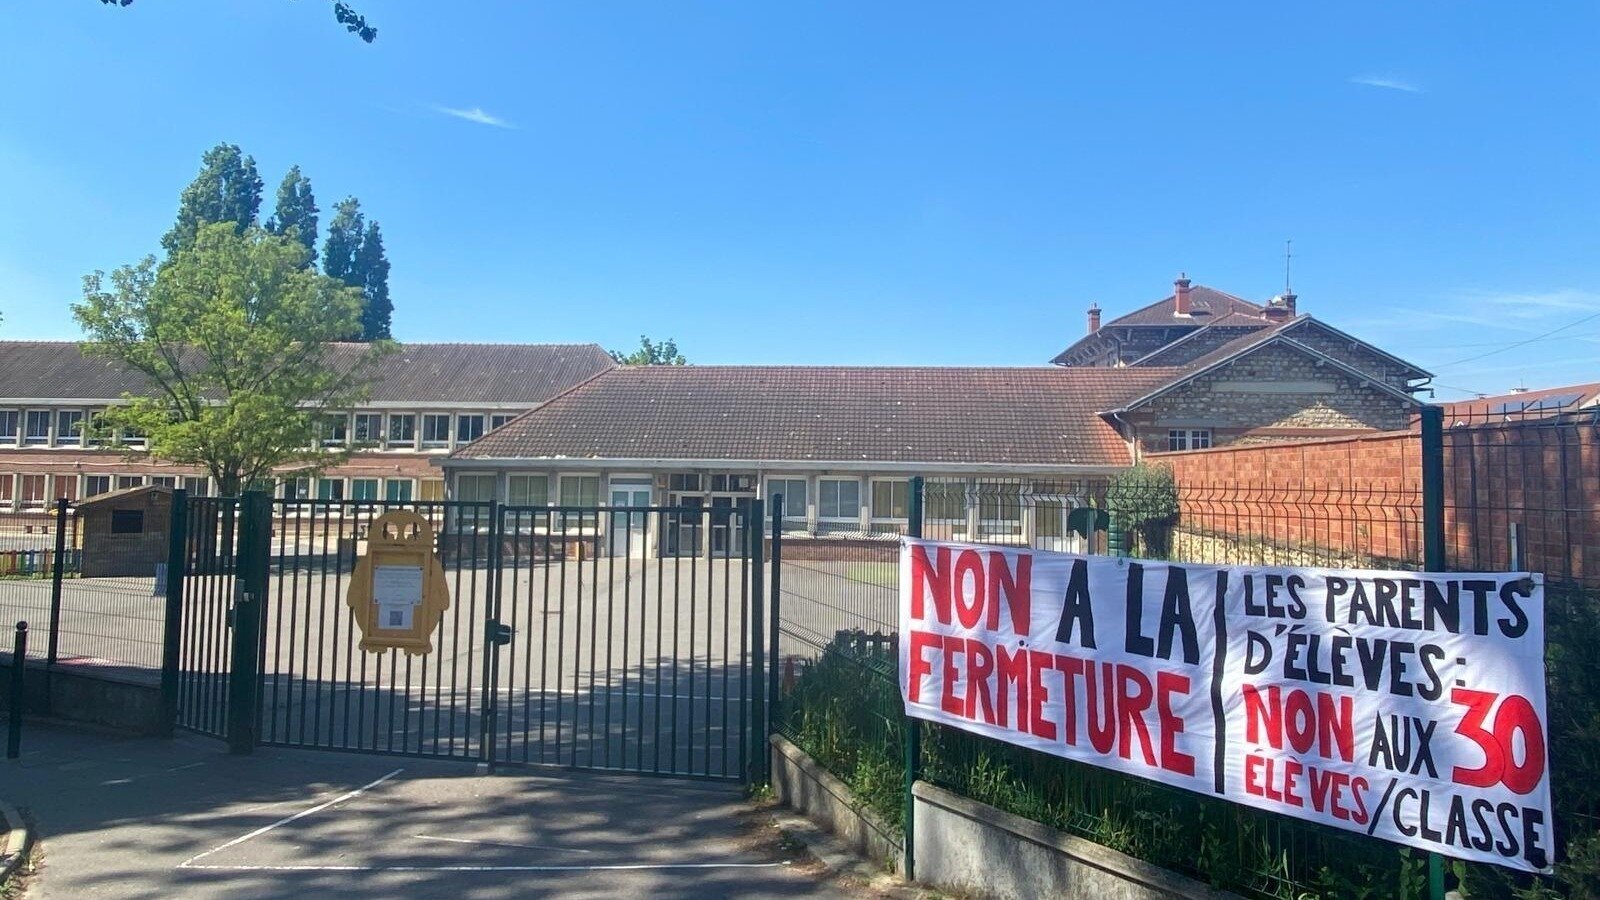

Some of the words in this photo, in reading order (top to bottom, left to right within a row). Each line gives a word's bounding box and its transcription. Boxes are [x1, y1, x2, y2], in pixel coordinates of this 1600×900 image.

[911, 545, 1032, 636] NON
[1055, 559, 1097, 649] A
[1125, 562, 1199, 665] LA
[1244, 575, 1306, 619] LES
[1326, 576, 1532, 638] PARENTS
[908, 631, 1195, 777] FERMETURE
[1243, 684, 1354, 762] NON
[1368, 711, 1438, 778] AUX
[1451, 688, 1545, 795] 30
